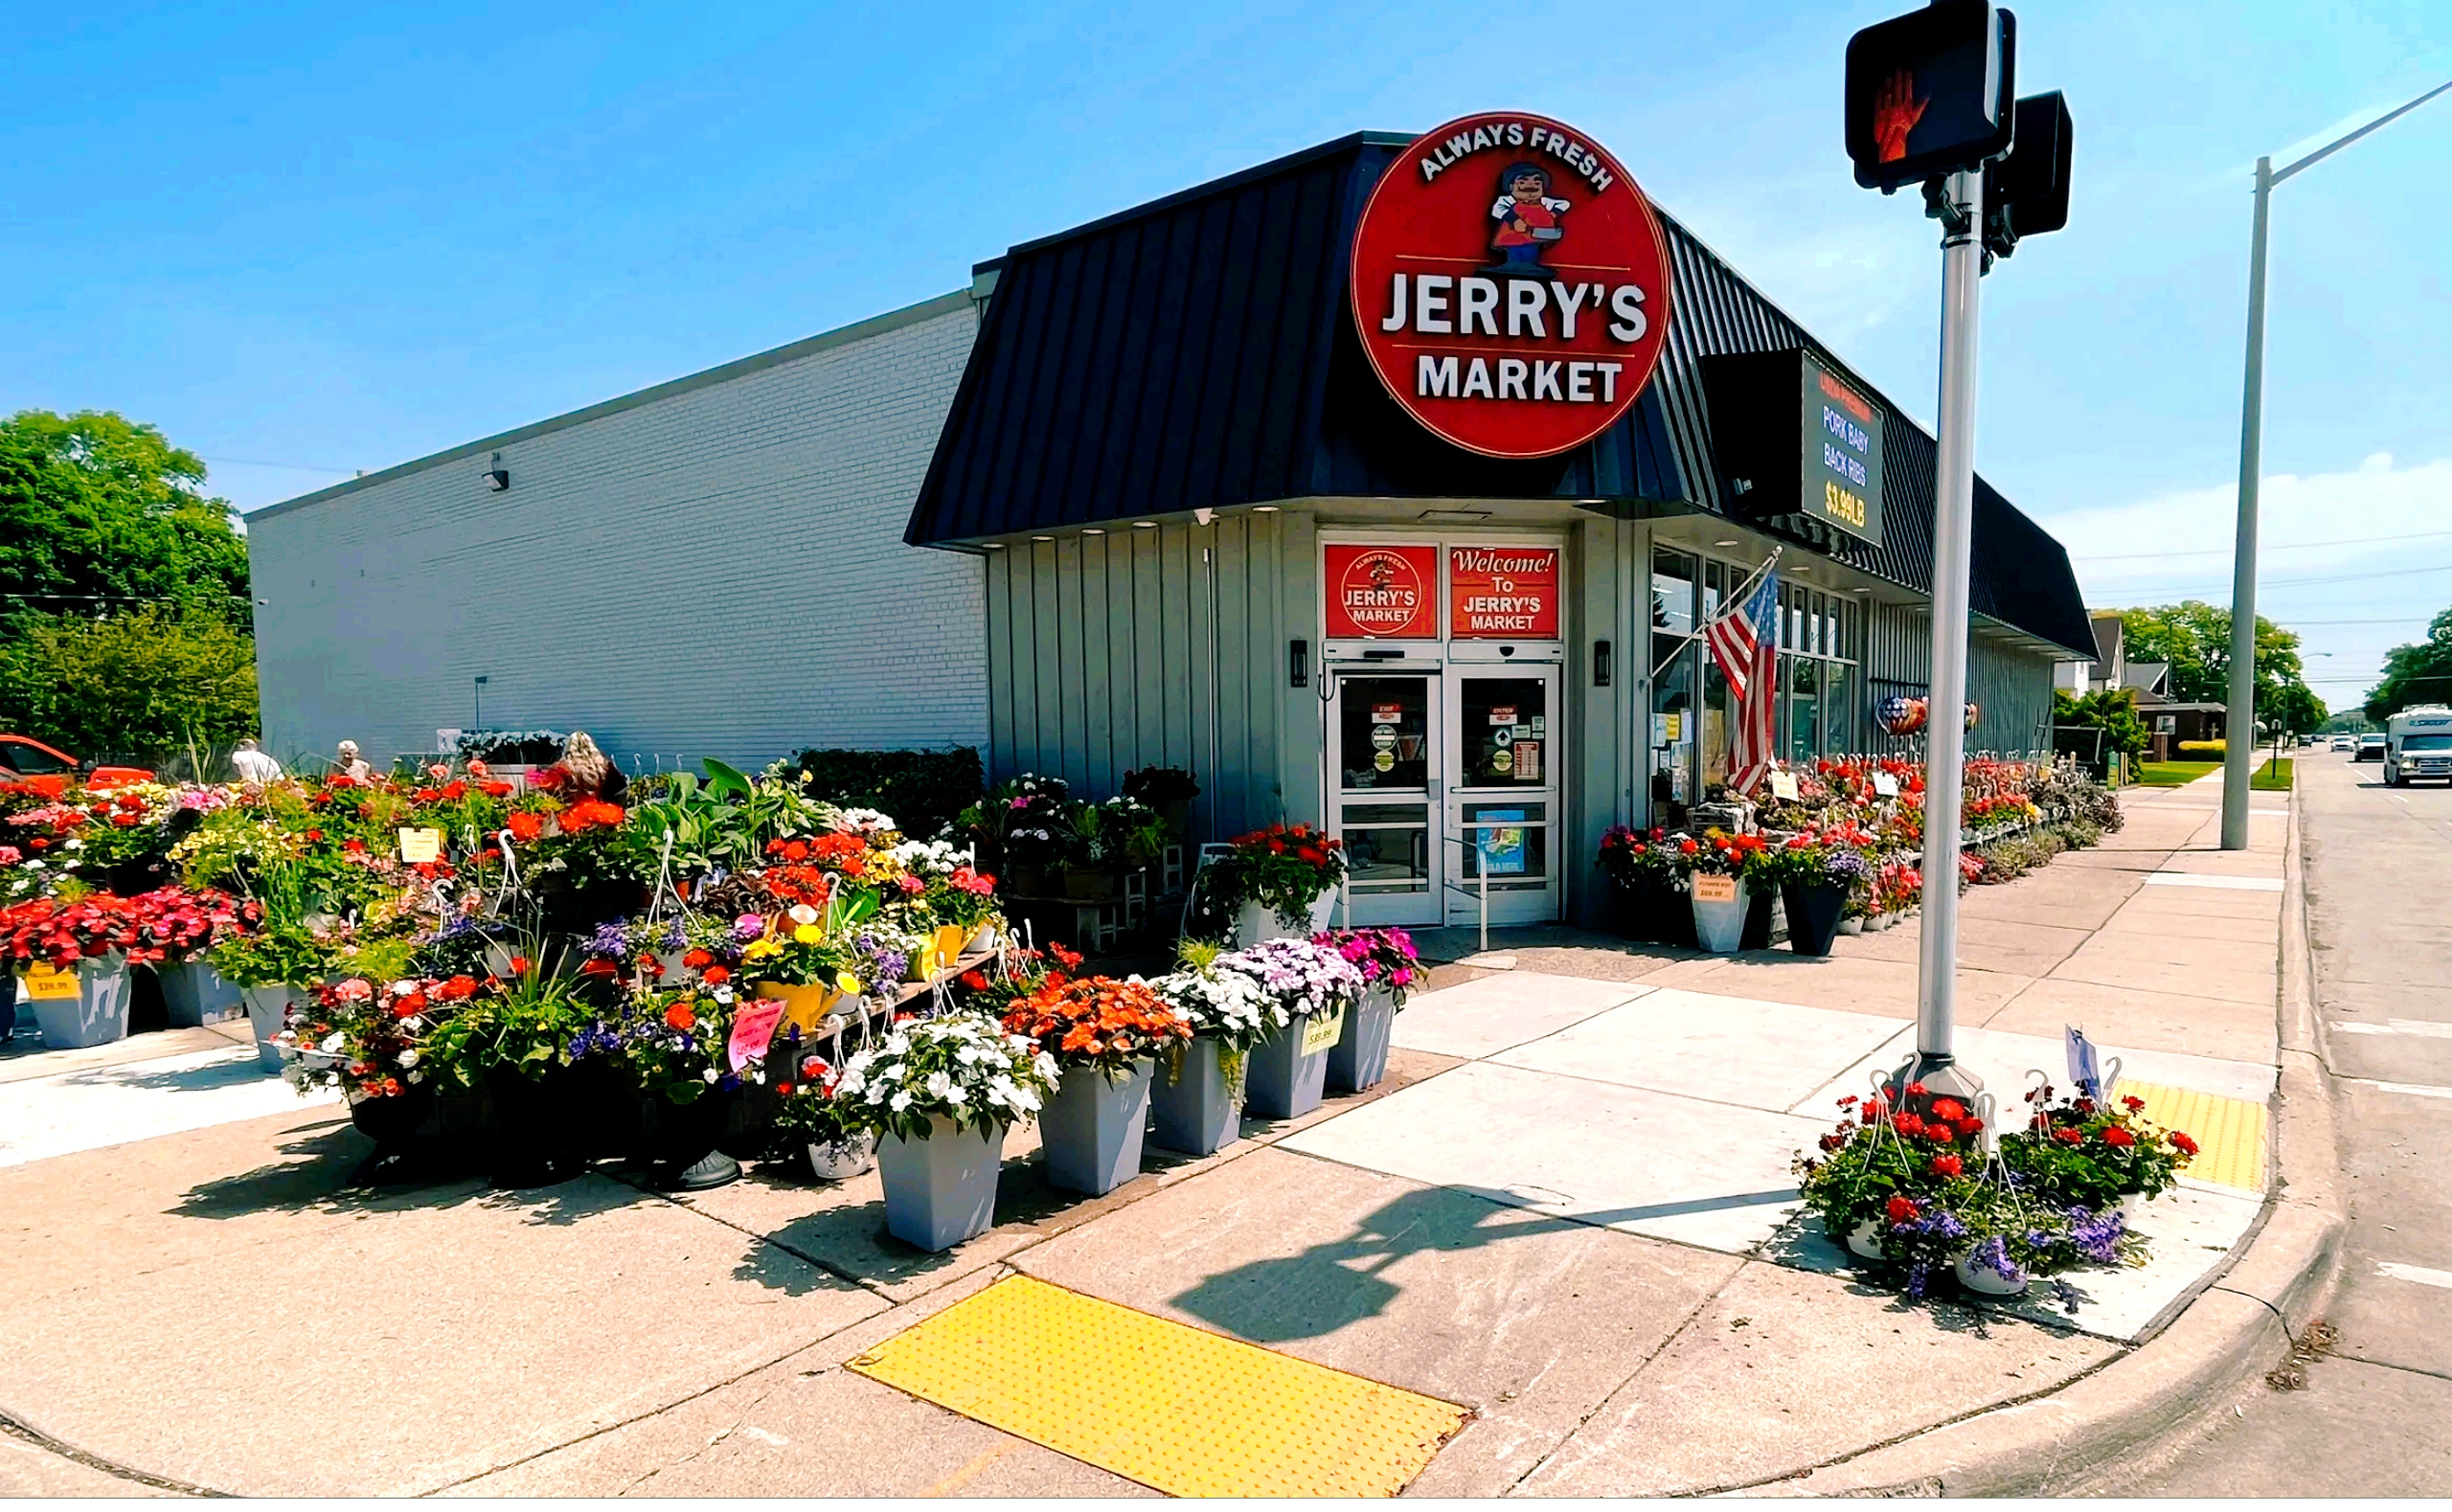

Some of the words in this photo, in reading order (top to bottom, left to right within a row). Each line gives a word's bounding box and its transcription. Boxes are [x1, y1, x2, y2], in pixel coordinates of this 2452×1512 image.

[1420, 123, 1524, 181] ALWAYS
[1530, 126, 1613, 192] FRESH
[1382, 273, 1647, 343] JERRY'S
[1418, 354, 1623, 403] MARKET
[1823, 405, 1848, 441] PORK
[1848, 422, 1869, 456] BABY
[1824, 441, 1848, 477] BACK
[1355, 554, 1383, 571] ALWAYS
[1452, 551, 1554, 573] Welcome!
[1491, 576, 1513, 593] To
[1345, 590, 1415, 606] JERRY'S
[1463, 597, 1541, 613] JERRY'S
[1352, 610, 1410, 622] MARKET
[1470, 615, 1535, 630] MARKET
